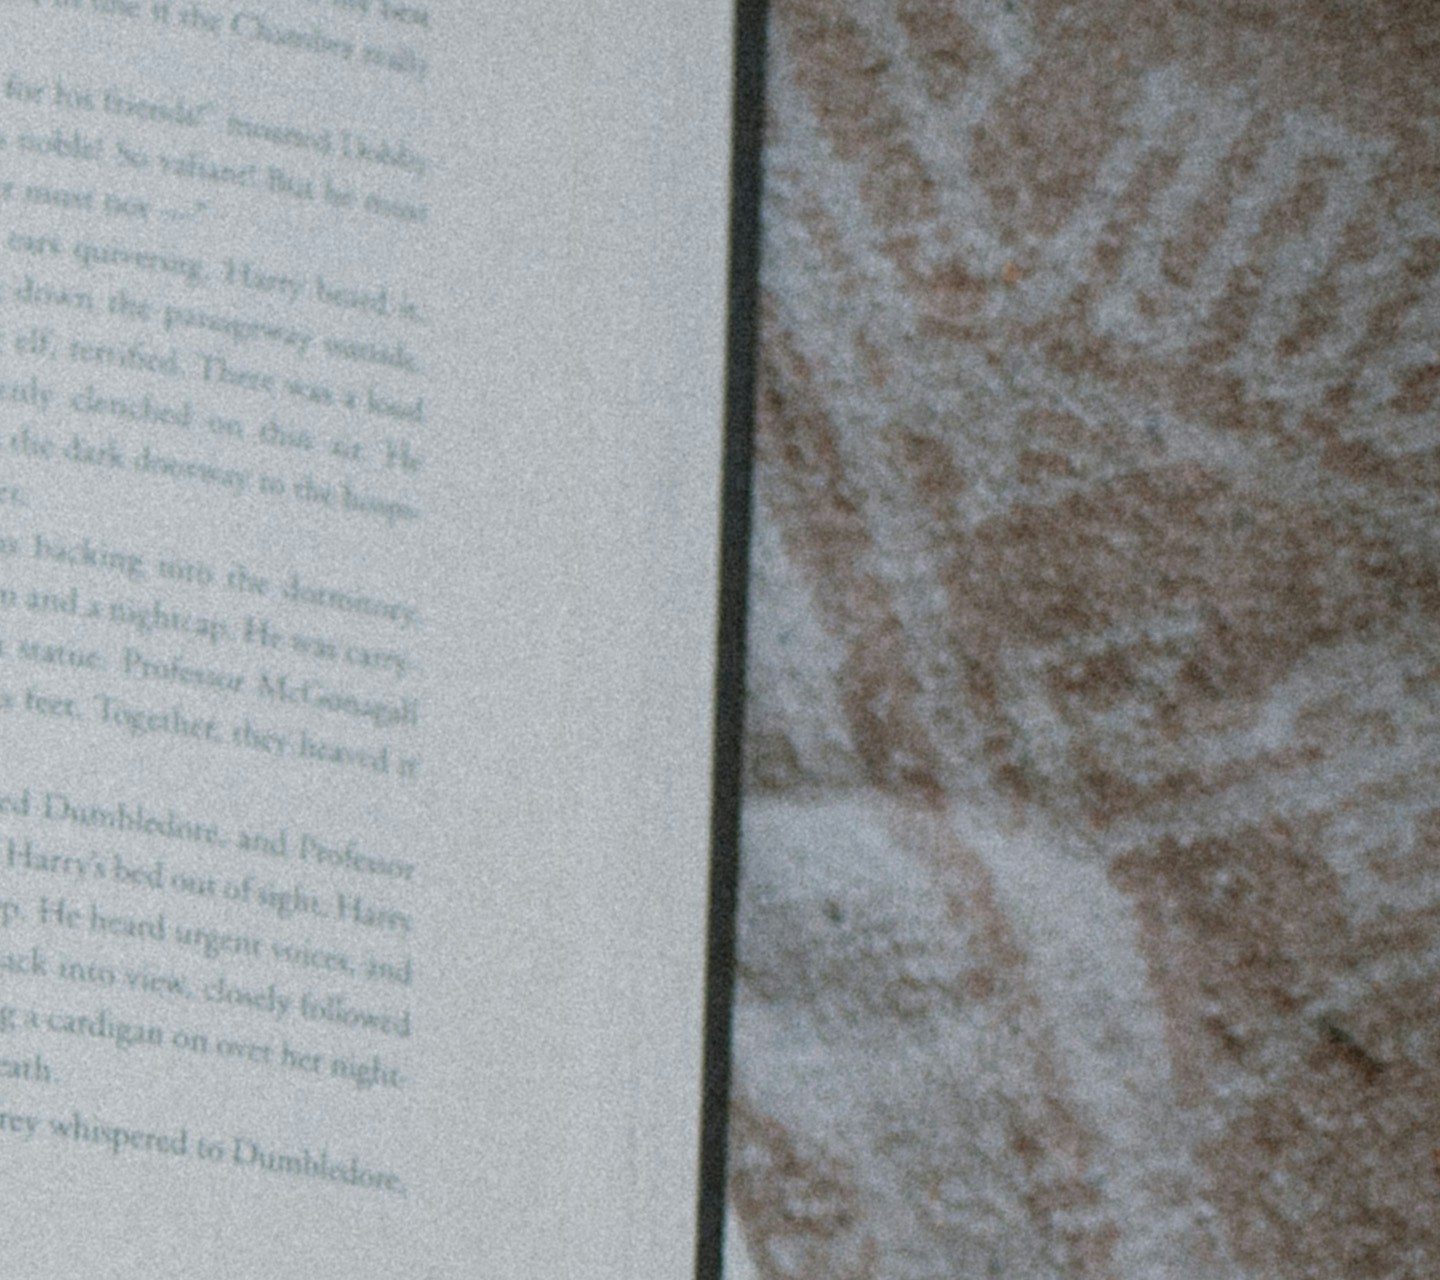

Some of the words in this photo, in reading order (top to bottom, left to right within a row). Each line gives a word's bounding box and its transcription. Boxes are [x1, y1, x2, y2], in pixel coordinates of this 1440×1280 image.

[47, 1109, 189, 1157] whispered
[194, 1137, 227, 1163] to
[230, 1134, 408, 1198] Dumbledore,
